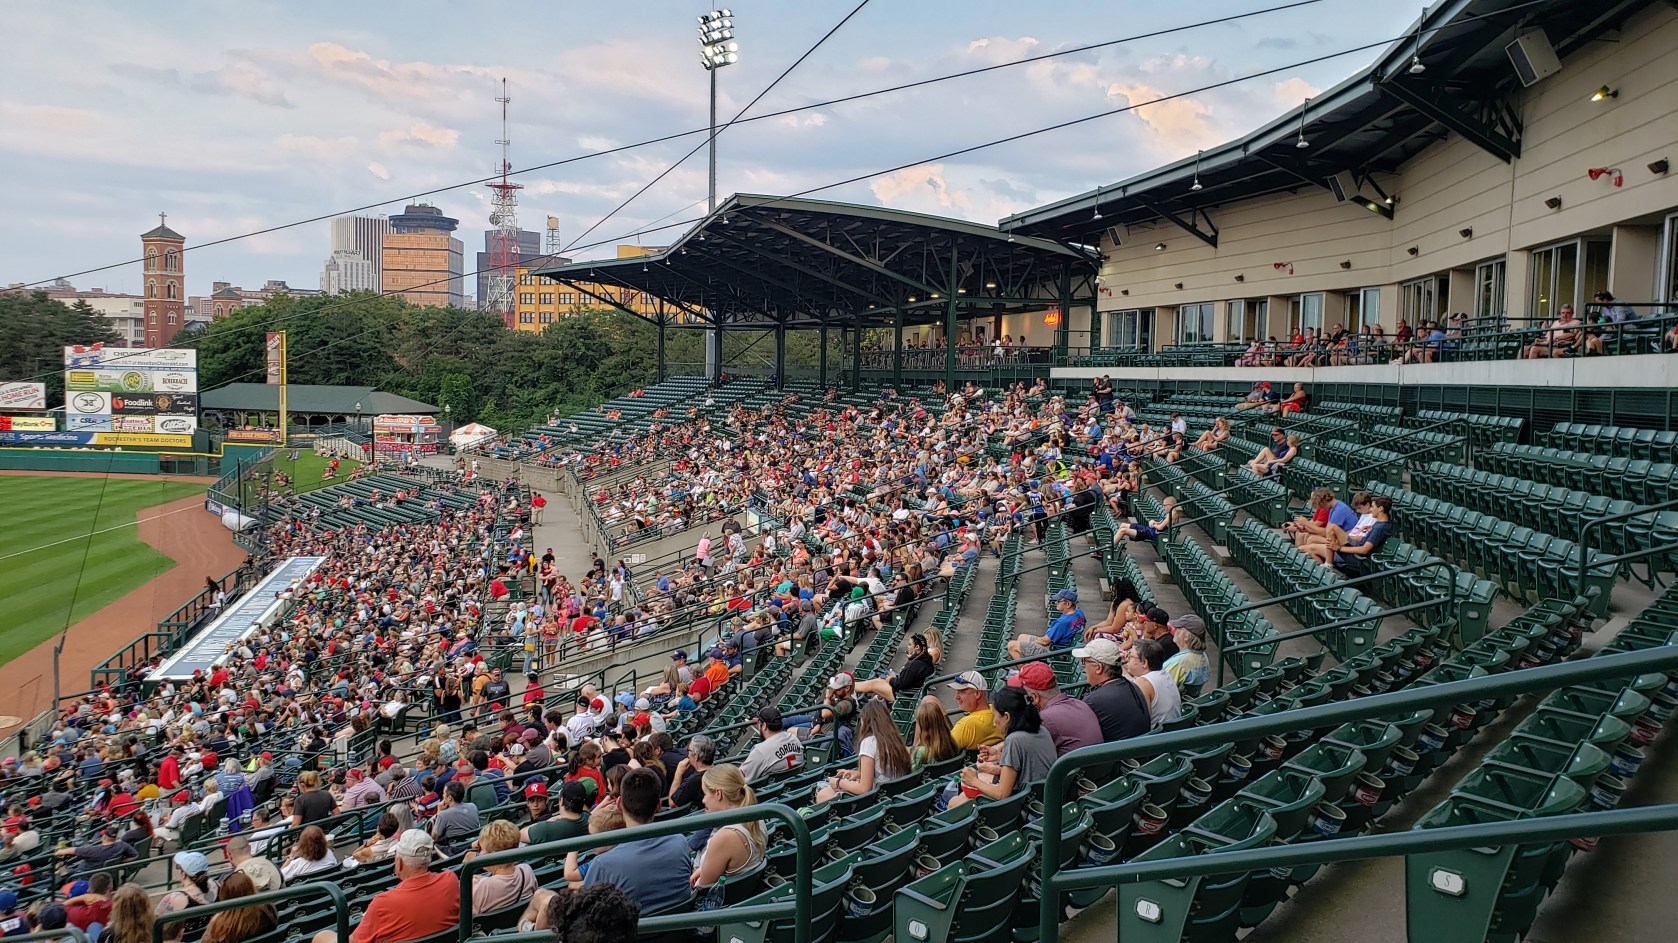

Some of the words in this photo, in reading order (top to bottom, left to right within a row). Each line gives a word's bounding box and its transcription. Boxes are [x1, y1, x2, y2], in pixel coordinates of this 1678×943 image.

[2, 390, 23, 400] HOME
[24, 387, 39, 395] RUN
[775, 742, 800, 759] GORDON
[530, 784, 538, 792] R
